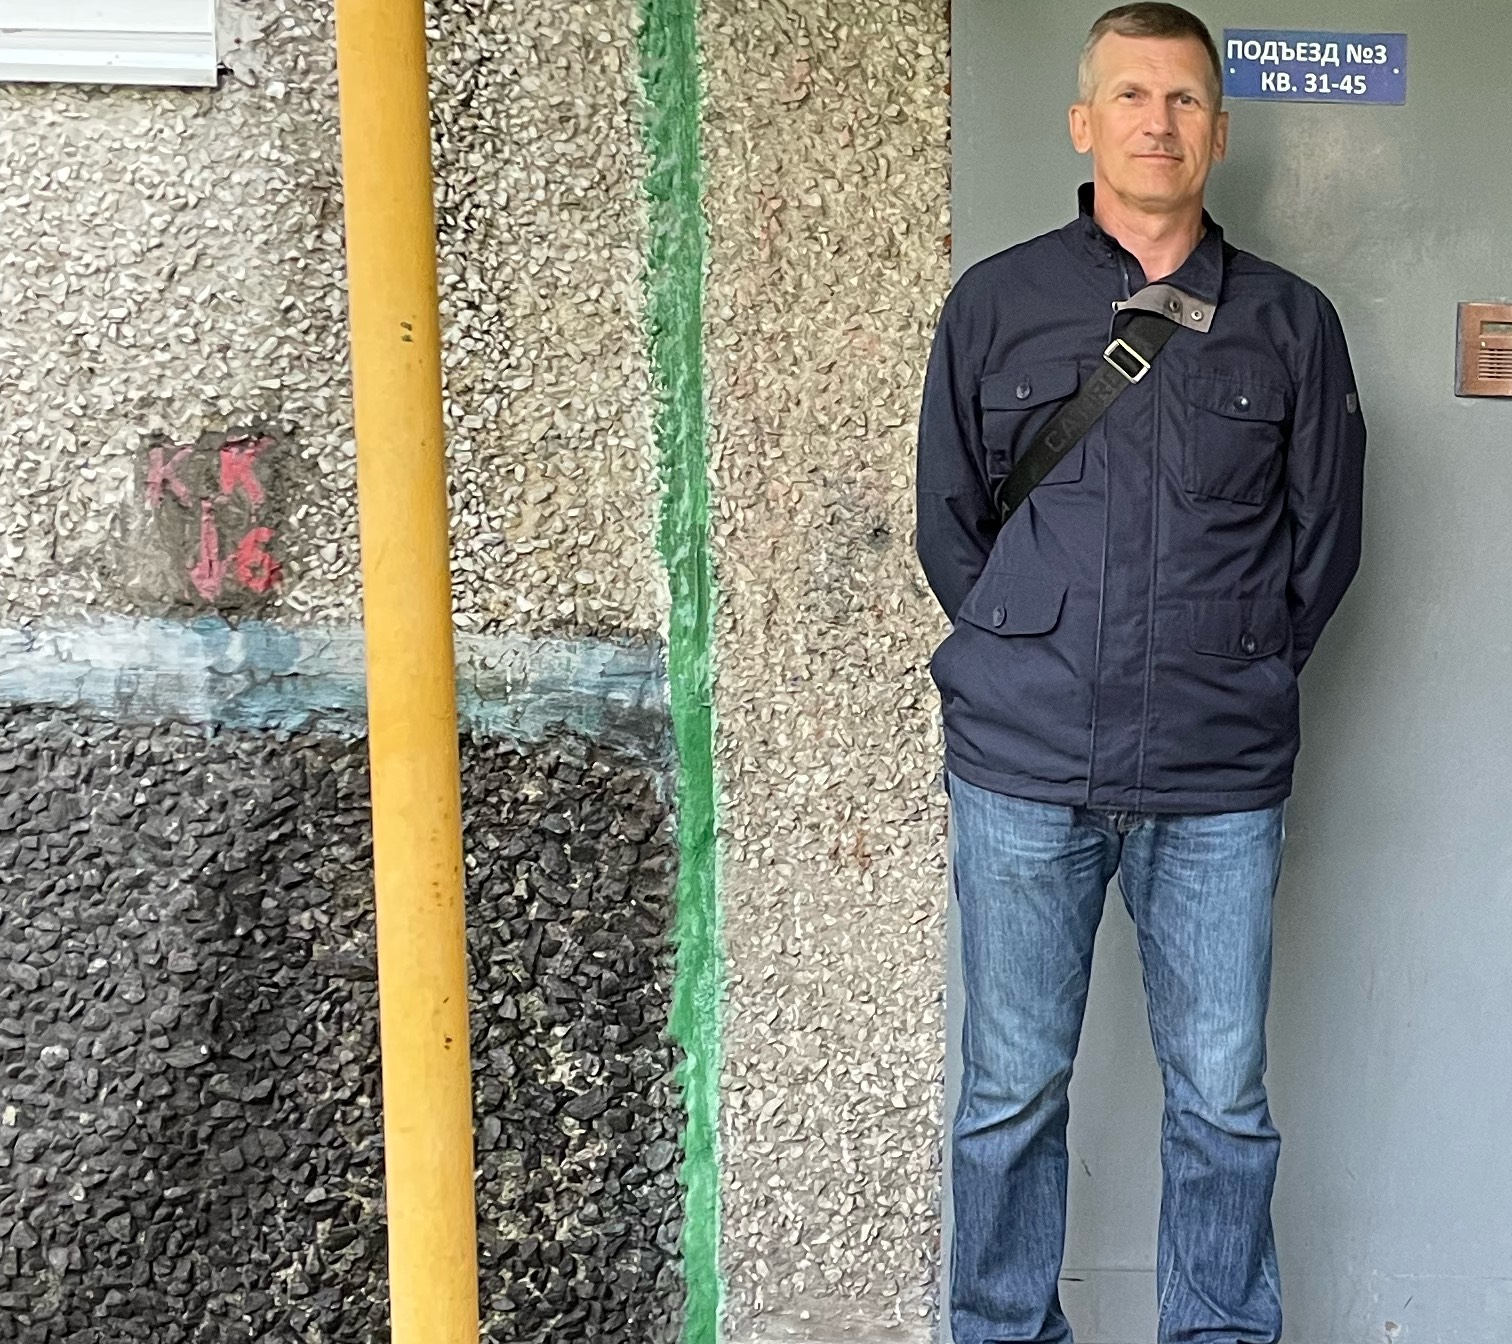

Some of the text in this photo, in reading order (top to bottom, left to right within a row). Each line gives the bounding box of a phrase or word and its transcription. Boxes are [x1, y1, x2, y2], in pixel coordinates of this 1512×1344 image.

[1227, 39, 1387, 67] ПОДЪЕЗД №3
[1261, 71, 1367, 95] КВ. 31-45
